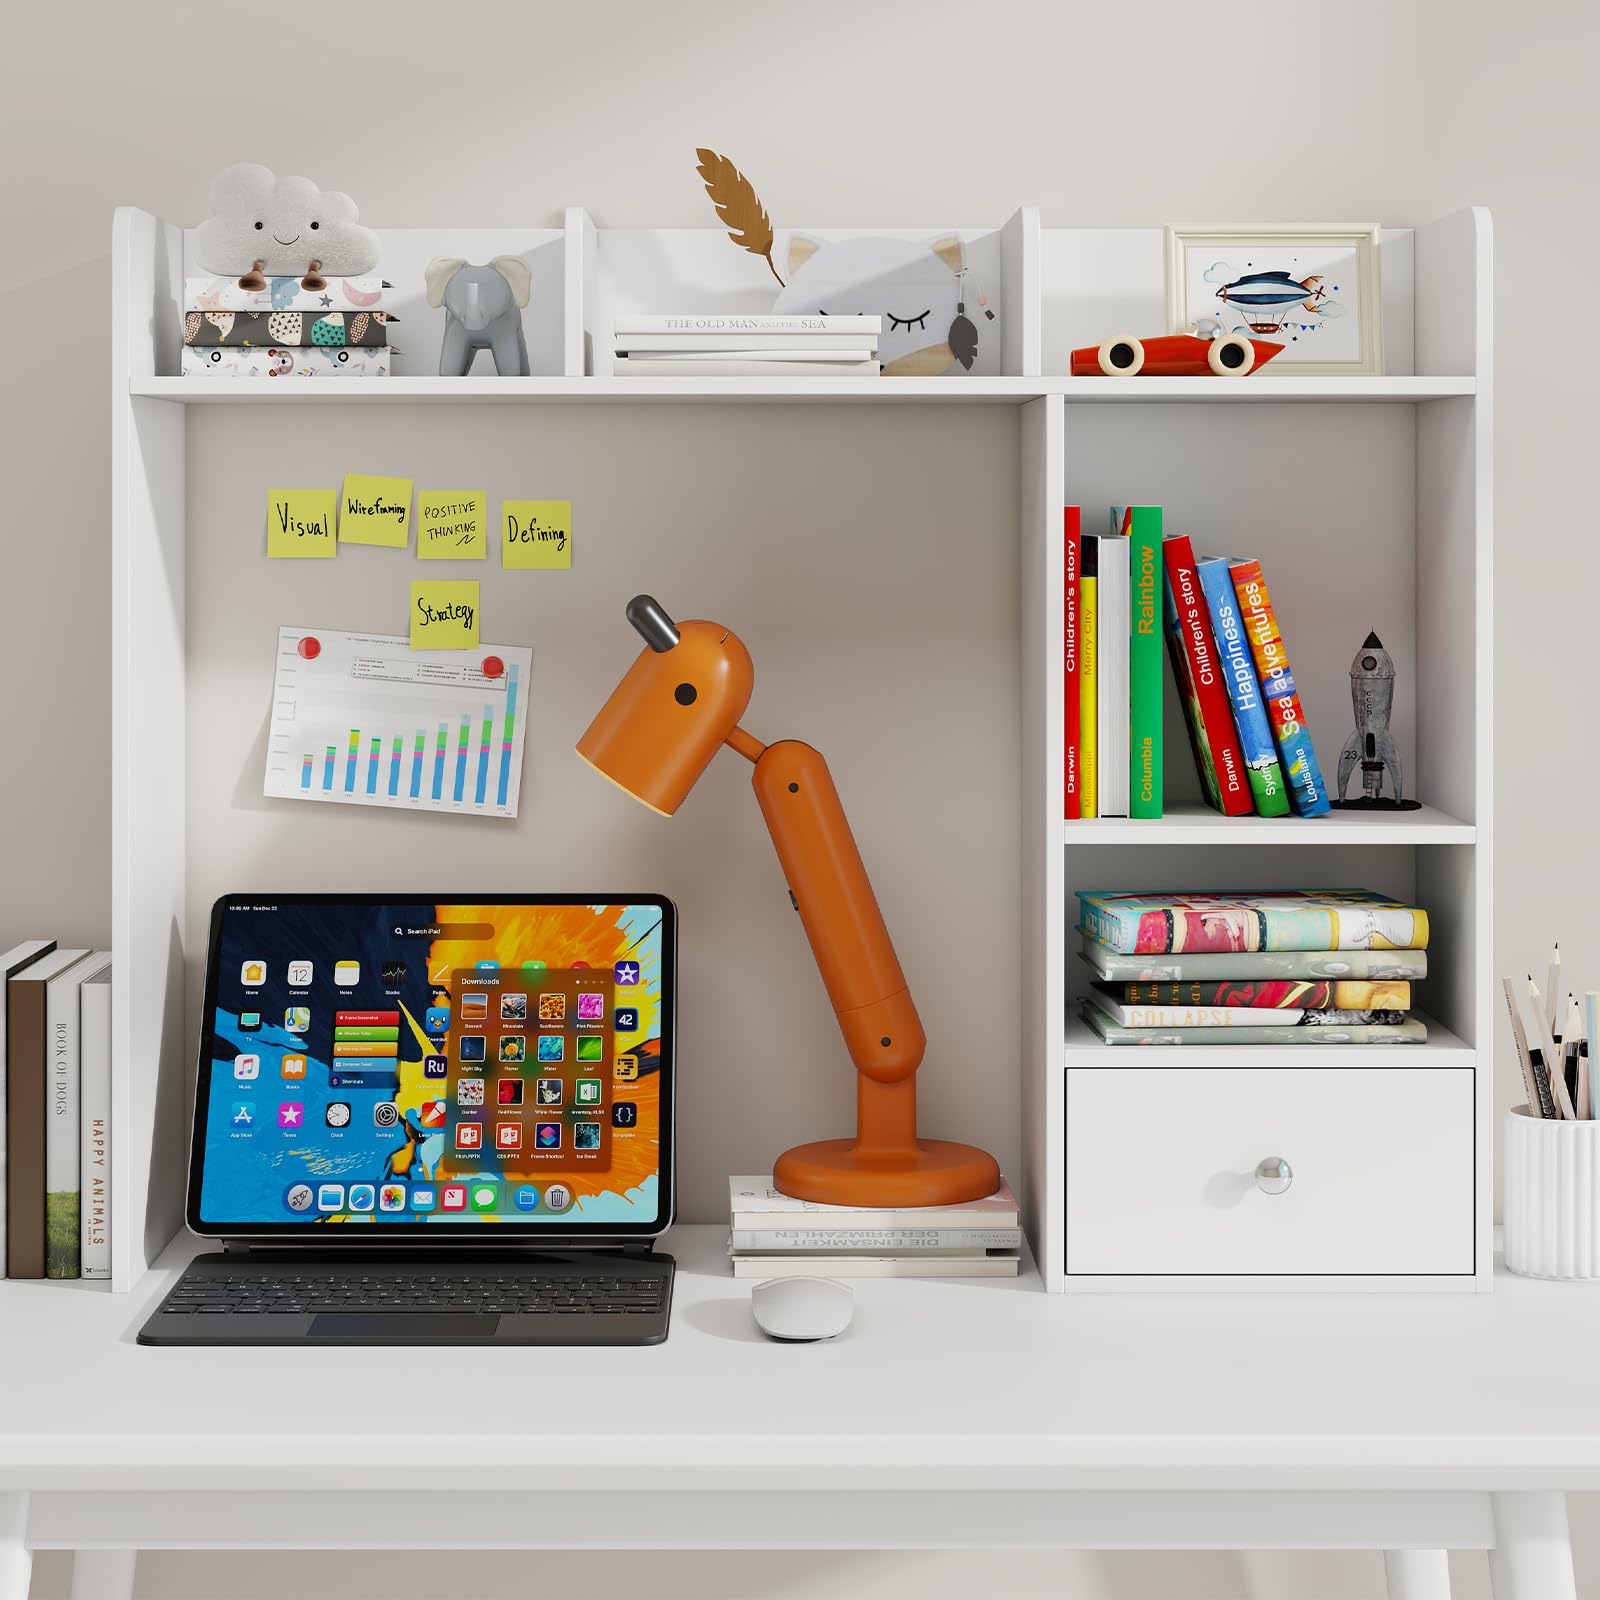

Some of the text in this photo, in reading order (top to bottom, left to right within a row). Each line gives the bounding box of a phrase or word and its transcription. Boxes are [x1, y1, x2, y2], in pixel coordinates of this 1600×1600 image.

[665, 319, 694, 329] THE
[696, 319, 725, 329] OLD
[729, 319, 759, 329] MAN
[801, 319, 826, 329] SEA
[277, 502, 328, 538] Visual
[348, 497, 406, 523] Wireframing
[424, 501, 477, 519] POSITIVE
[427, 521, 477, 541] THINKING
[508, 515, 567, 552] Defining
[1066, 539, 1077, 672] Children's story
[1138, 545, 1155, 635] Rainbow
[418, 597, 474, 630] Strategy
[1177, 567, 1214, 686] Children's story
[1084, 608, 1093, 676] Merry City
[1220, 605, 1257, 711] Happiness
[1246, 582, 1301, 736] Sea adventures
[1067, 745, 1075, 794] Darwin
[1141, 737, 1153, 802] Columbia
[1222, 748, 1240, 792] Darwin
[1344, 750, 1358, 760] 23
[1295, 748, 1318, 804] Louisiana
[293, 969, 308, 982] 12
[618, 1014, 633, 1026] 42
[1129, 1010, 1234, 1027] COLLAPSE
[56, 1022, 67, 1117] BOOK OF DOGS
[427, 1060, 445, 1073] Ru
[92, 1119, 105, 1246] HAPPY ANIMALS
[774, 1231, 896, 1239] PRIMZAHLEN
[791, 1239, 939, 1247] DIE EINSAMKEIT
